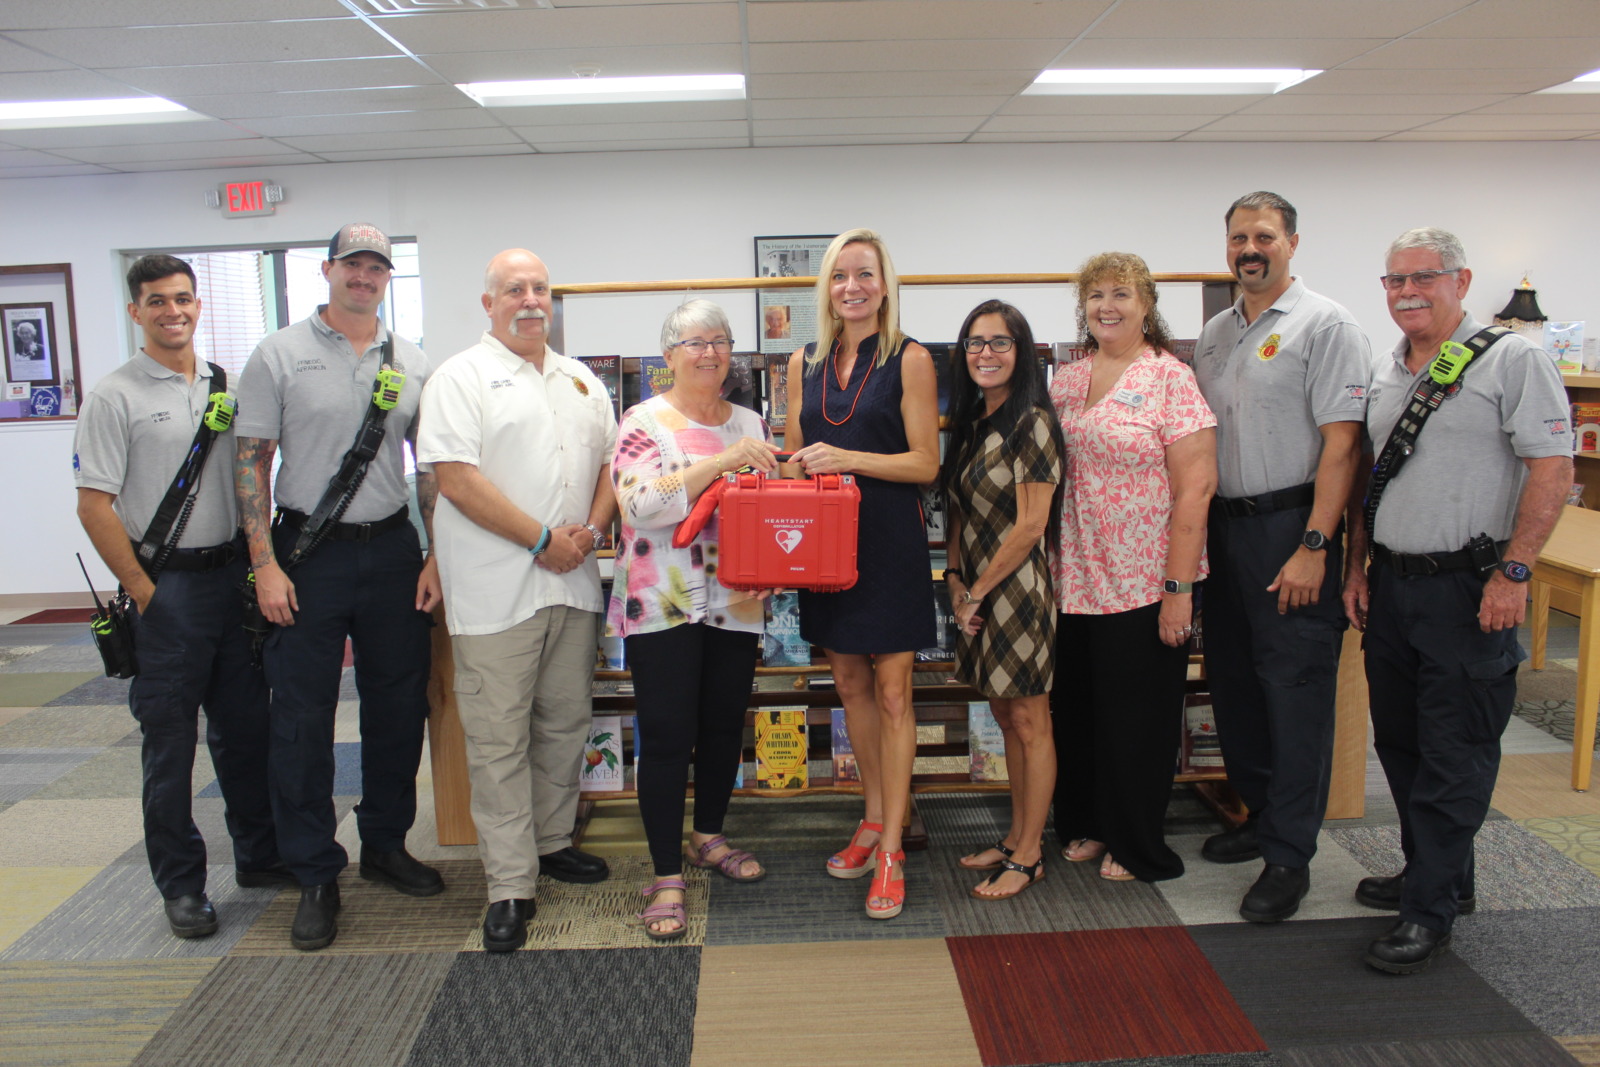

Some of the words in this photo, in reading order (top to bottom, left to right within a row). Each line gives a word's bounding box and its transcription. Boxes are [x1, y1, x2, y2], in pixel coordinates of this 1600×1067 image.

[226, 181, 264, 212] EXIT
[583, 359, 615, 368] EWARE
[766, 740, 799, 748] WHITEHEAD
